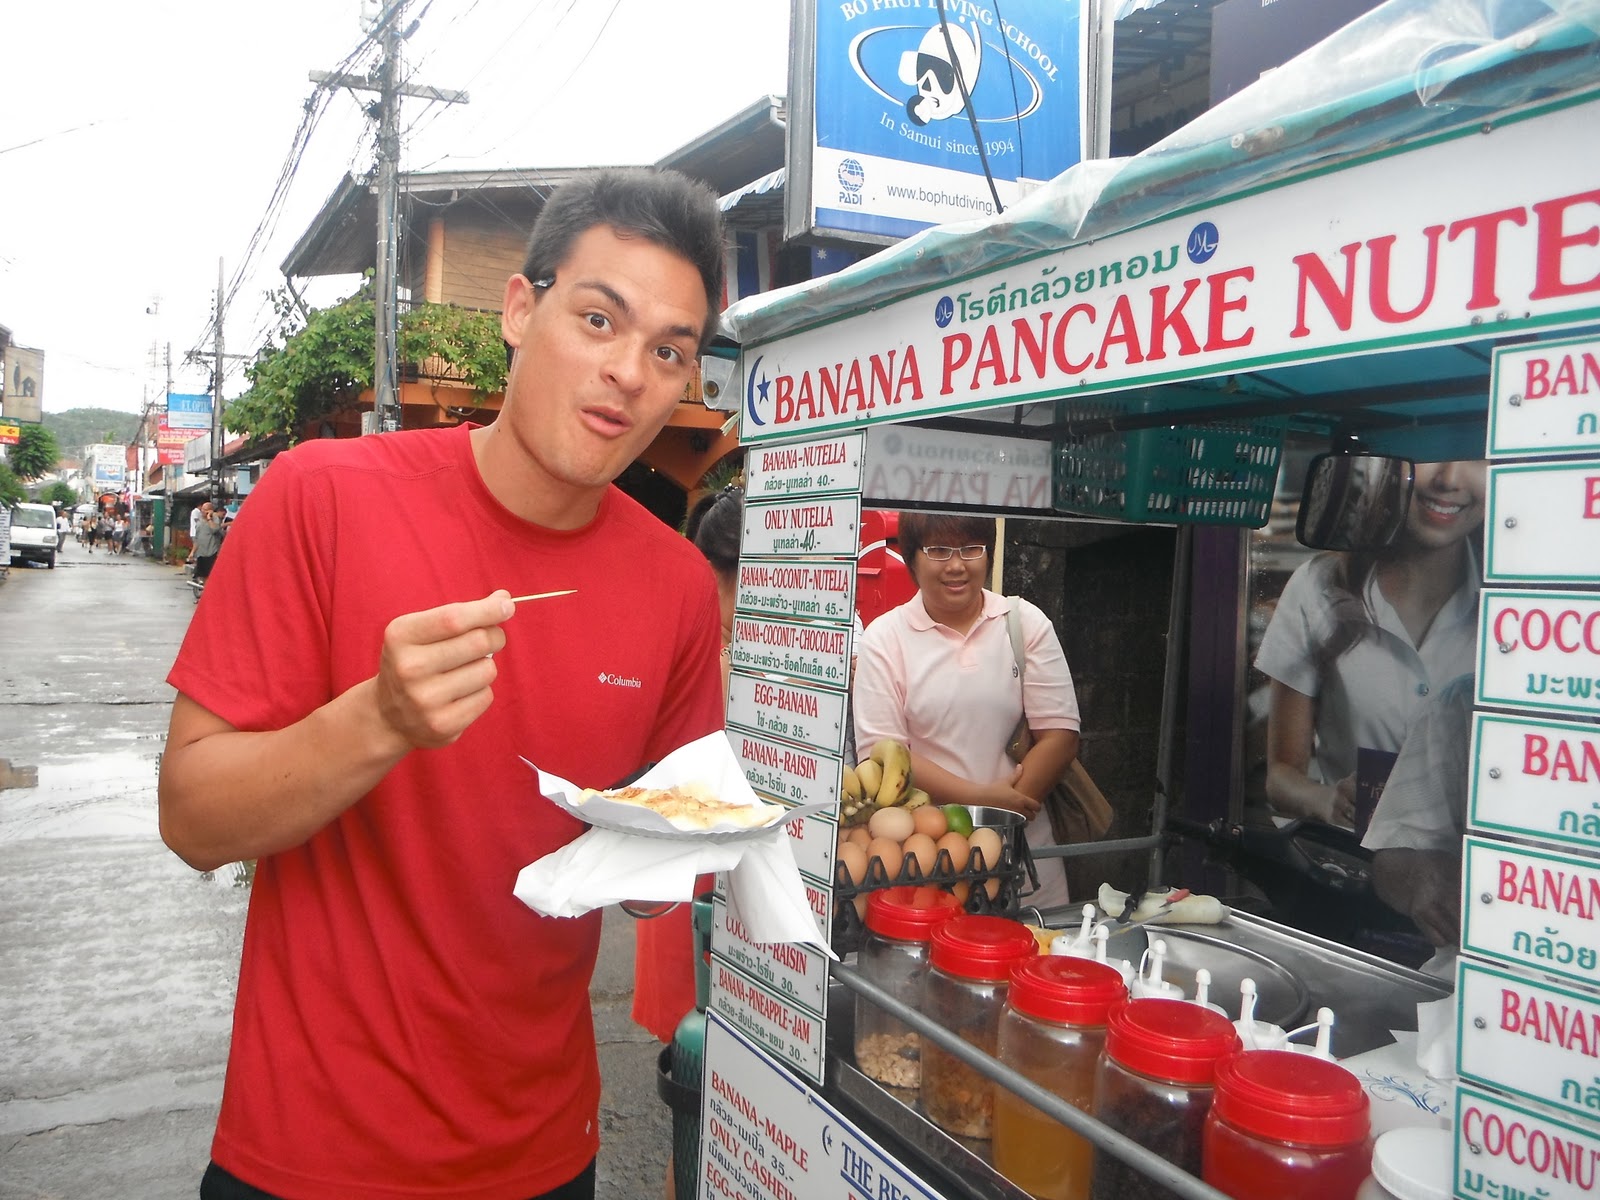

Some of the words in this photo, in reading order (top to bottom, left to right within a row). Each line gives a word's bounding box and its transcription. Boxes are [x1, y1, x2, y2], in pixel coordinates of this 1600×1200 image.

[840, 0, 868, 21] BO
[997, 18, 1060, 82] SCHOOL
[880, 112, 895, 131] In
[899, 122, 942, 150] Samui
[946, 139, 980, 156] since
[985, 138, 1015, 157] 1994
[838, 191, 863, 205] PADI
[957, 245, 1180, 323] โรตีกล้วยหอม
[774, 344, 924, 425] BANANA
[940, 265, 1255, 396] PANCAKE
[762, 442, 846, 472] BANANA-NUTELLA
[765, 510, 788, 529] ONLY
[790, 506, 833, 529] NUTELLA
[741, 566, 849, 592] BANANA-COCONUT-NUTELLA
[607, 673, 642, 688] Columbia
[754, 683, 818, 718] EGG-BANANA
[741, 739, 817, 780] BANANA-RAISIN
[719, 967, 810, 1044] BANANA-PINEAPPLE-JAM
[710, 1118, 740, 1158] ONLY
[712, 1070, 808, 1173] BANANA-MAPLE
[842, 1142, 873, 1193] THE
